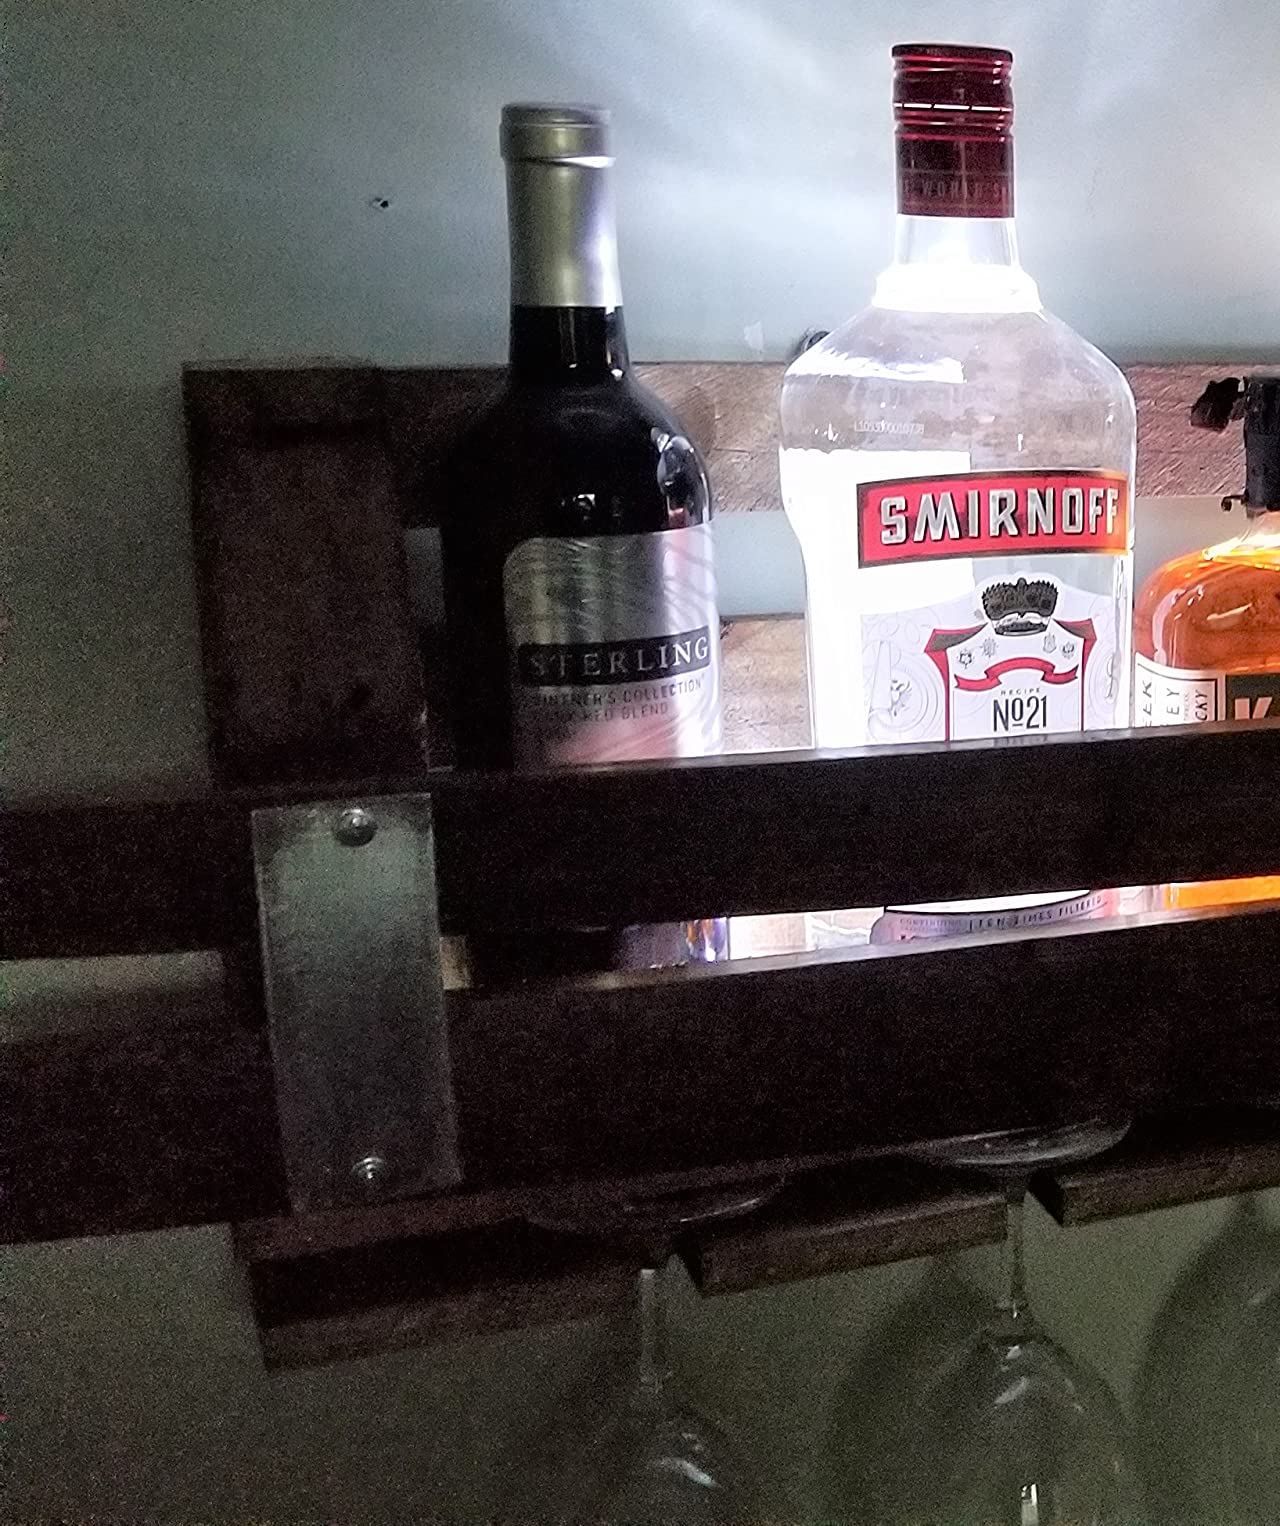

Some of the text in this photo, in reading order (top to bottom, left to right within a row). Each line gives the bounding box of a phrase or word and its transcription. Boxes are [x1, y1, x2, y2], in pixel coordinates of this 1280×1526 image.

[879, 486, 1120, 546] SMIRNOFF
[530, 635, 709, 677] STERLING
[622, 681, 702, 703] COLLECTION
[1001, 687, 1041, 696] RECIPE
